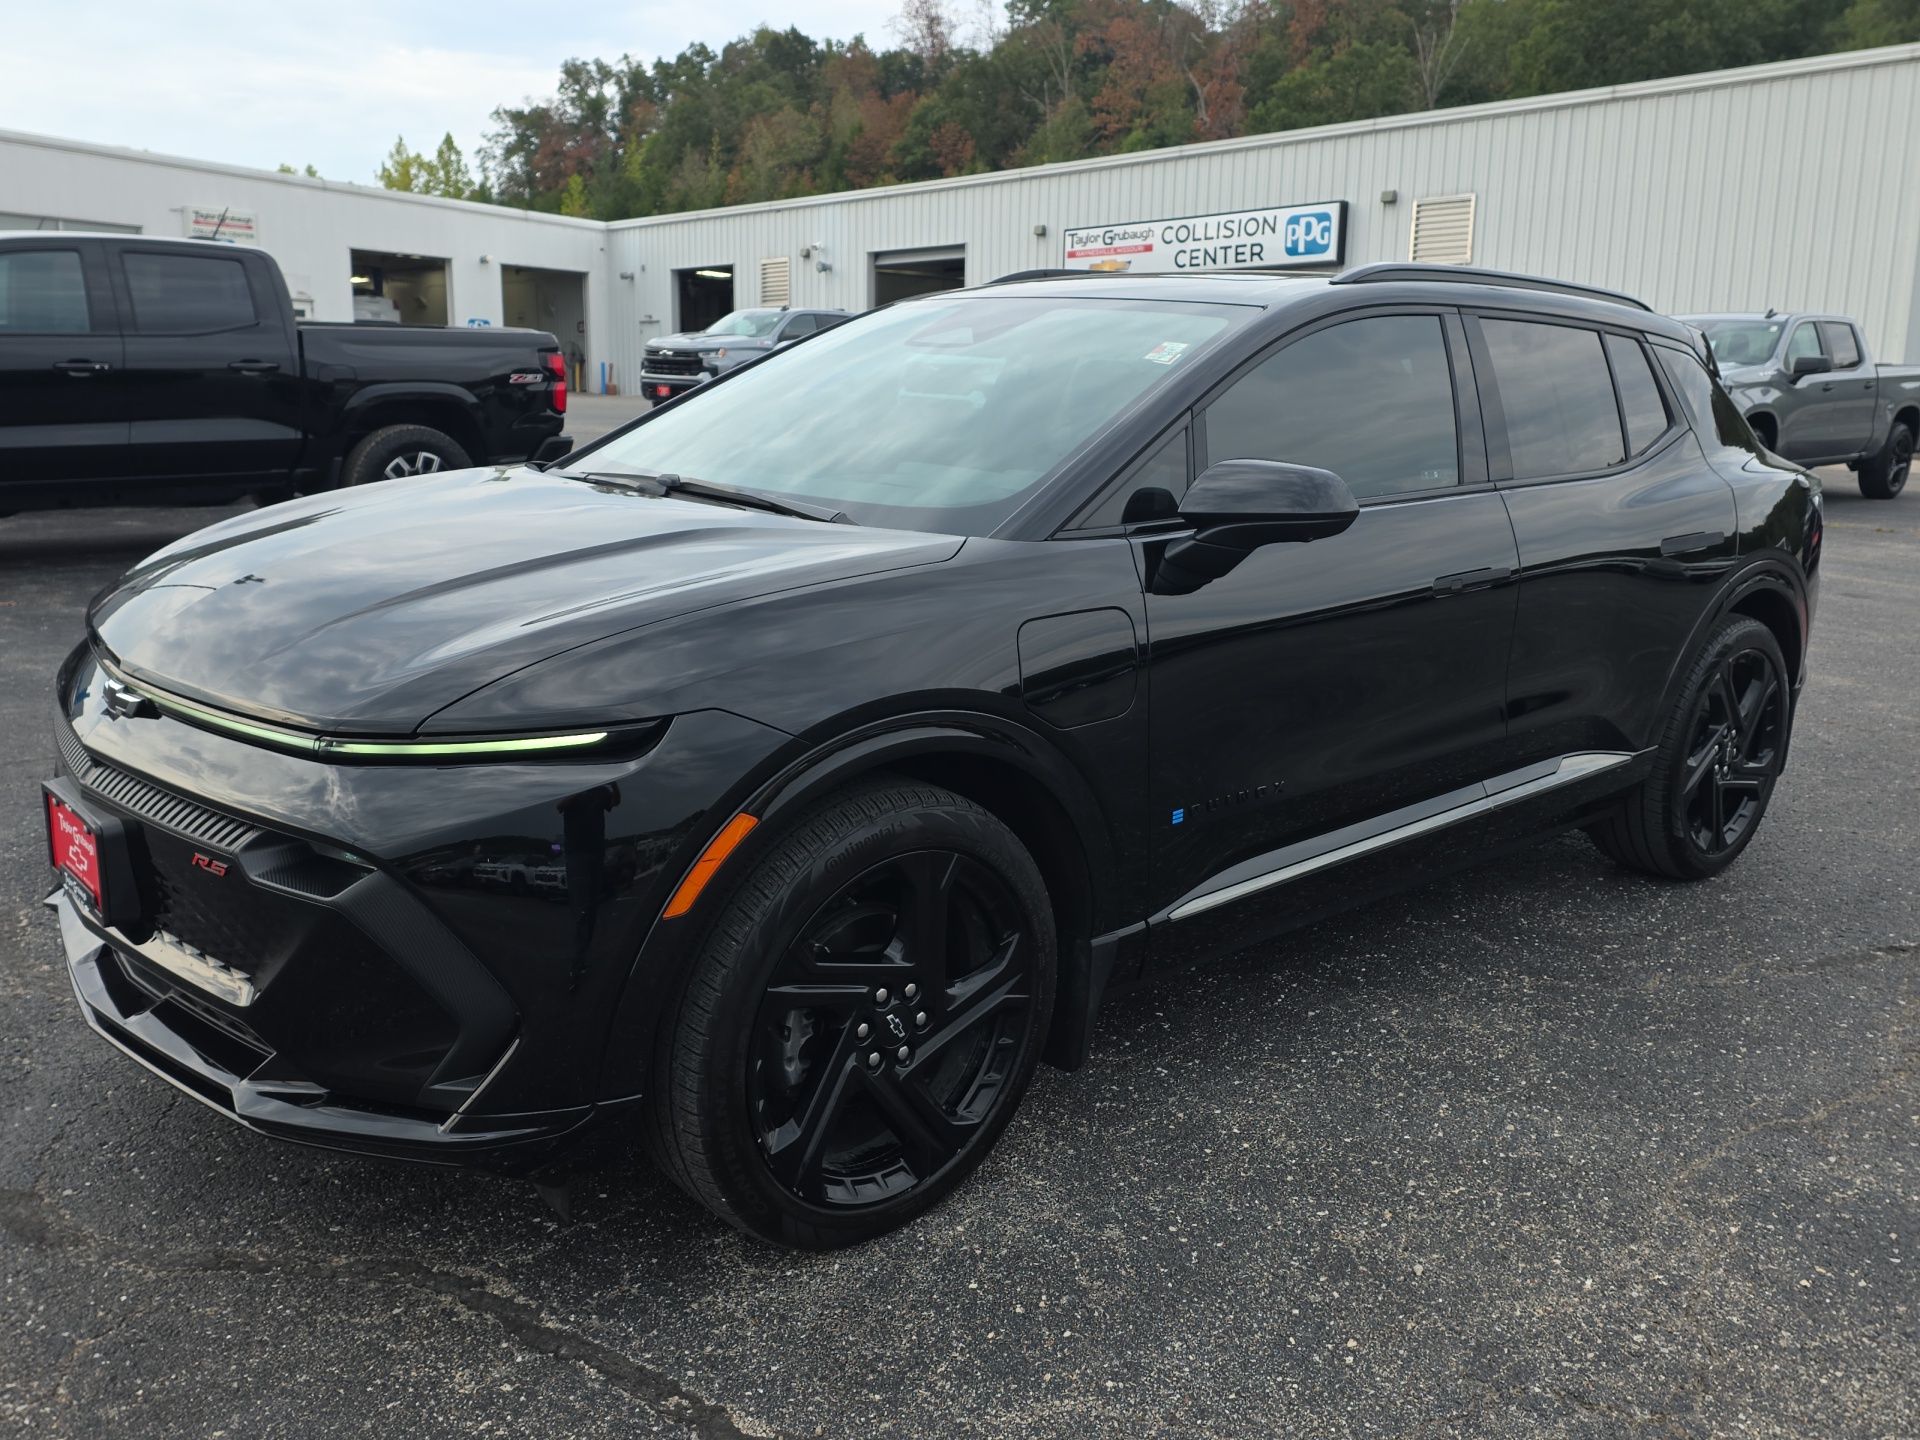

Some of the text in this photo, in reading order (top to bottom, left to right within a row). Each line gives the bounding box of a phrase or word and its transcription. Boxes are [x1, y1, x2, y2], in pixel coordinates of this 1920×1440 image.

[1067, 227, 1154, 249] Taylor Grubaugh
[1161, 215, 1277, 245] COLLISION
[1286, 216, 1330, 253] PPG
[1174, 242, 1264, 268] CENTER
[824, 822, 896, 873] Continental
[191, 852, 228, 877] RS
